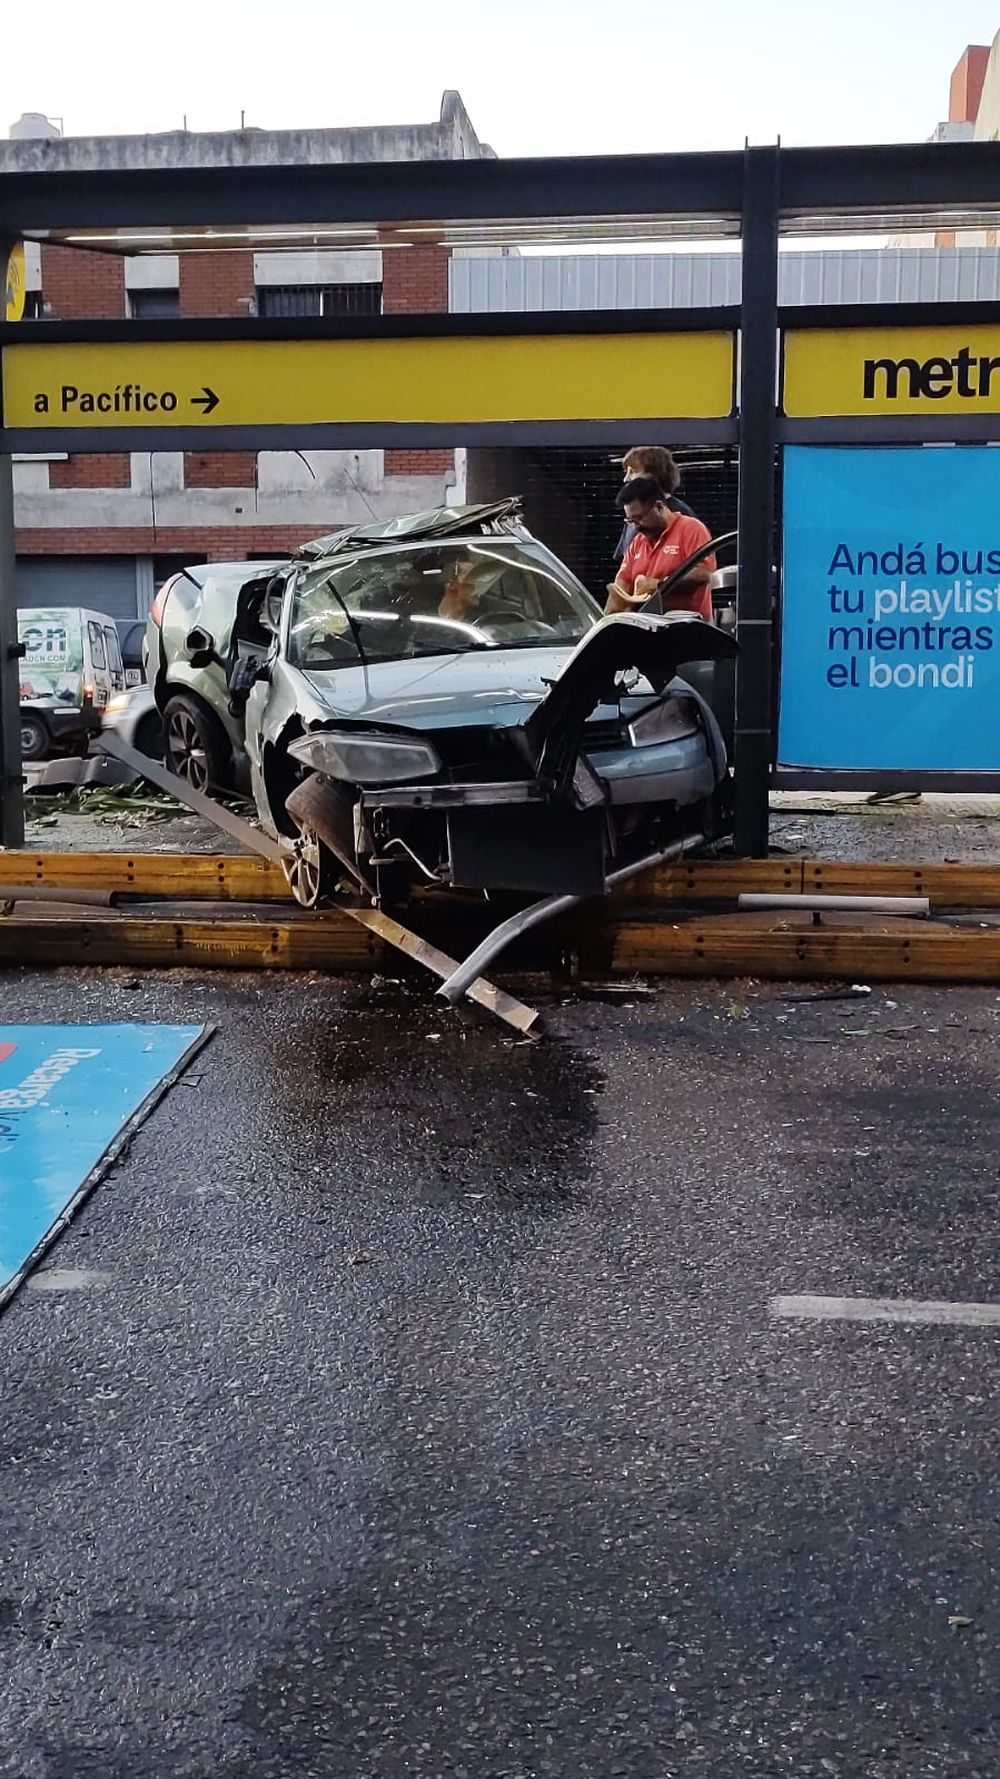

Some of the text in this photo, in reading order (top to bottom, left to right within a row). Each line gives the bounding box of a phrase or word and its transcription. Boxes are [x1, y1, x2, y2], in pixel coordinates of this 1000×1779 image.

[863, 347, 1000, 399] metr
[34, 385, 178, 412] a Pacífico
[827, 542, 1000, 576] Andá bus
[827, 585, 864, 614] tu
[828, 618, 993, 650] mientras
[826, 655, 975, 688] el bondi
